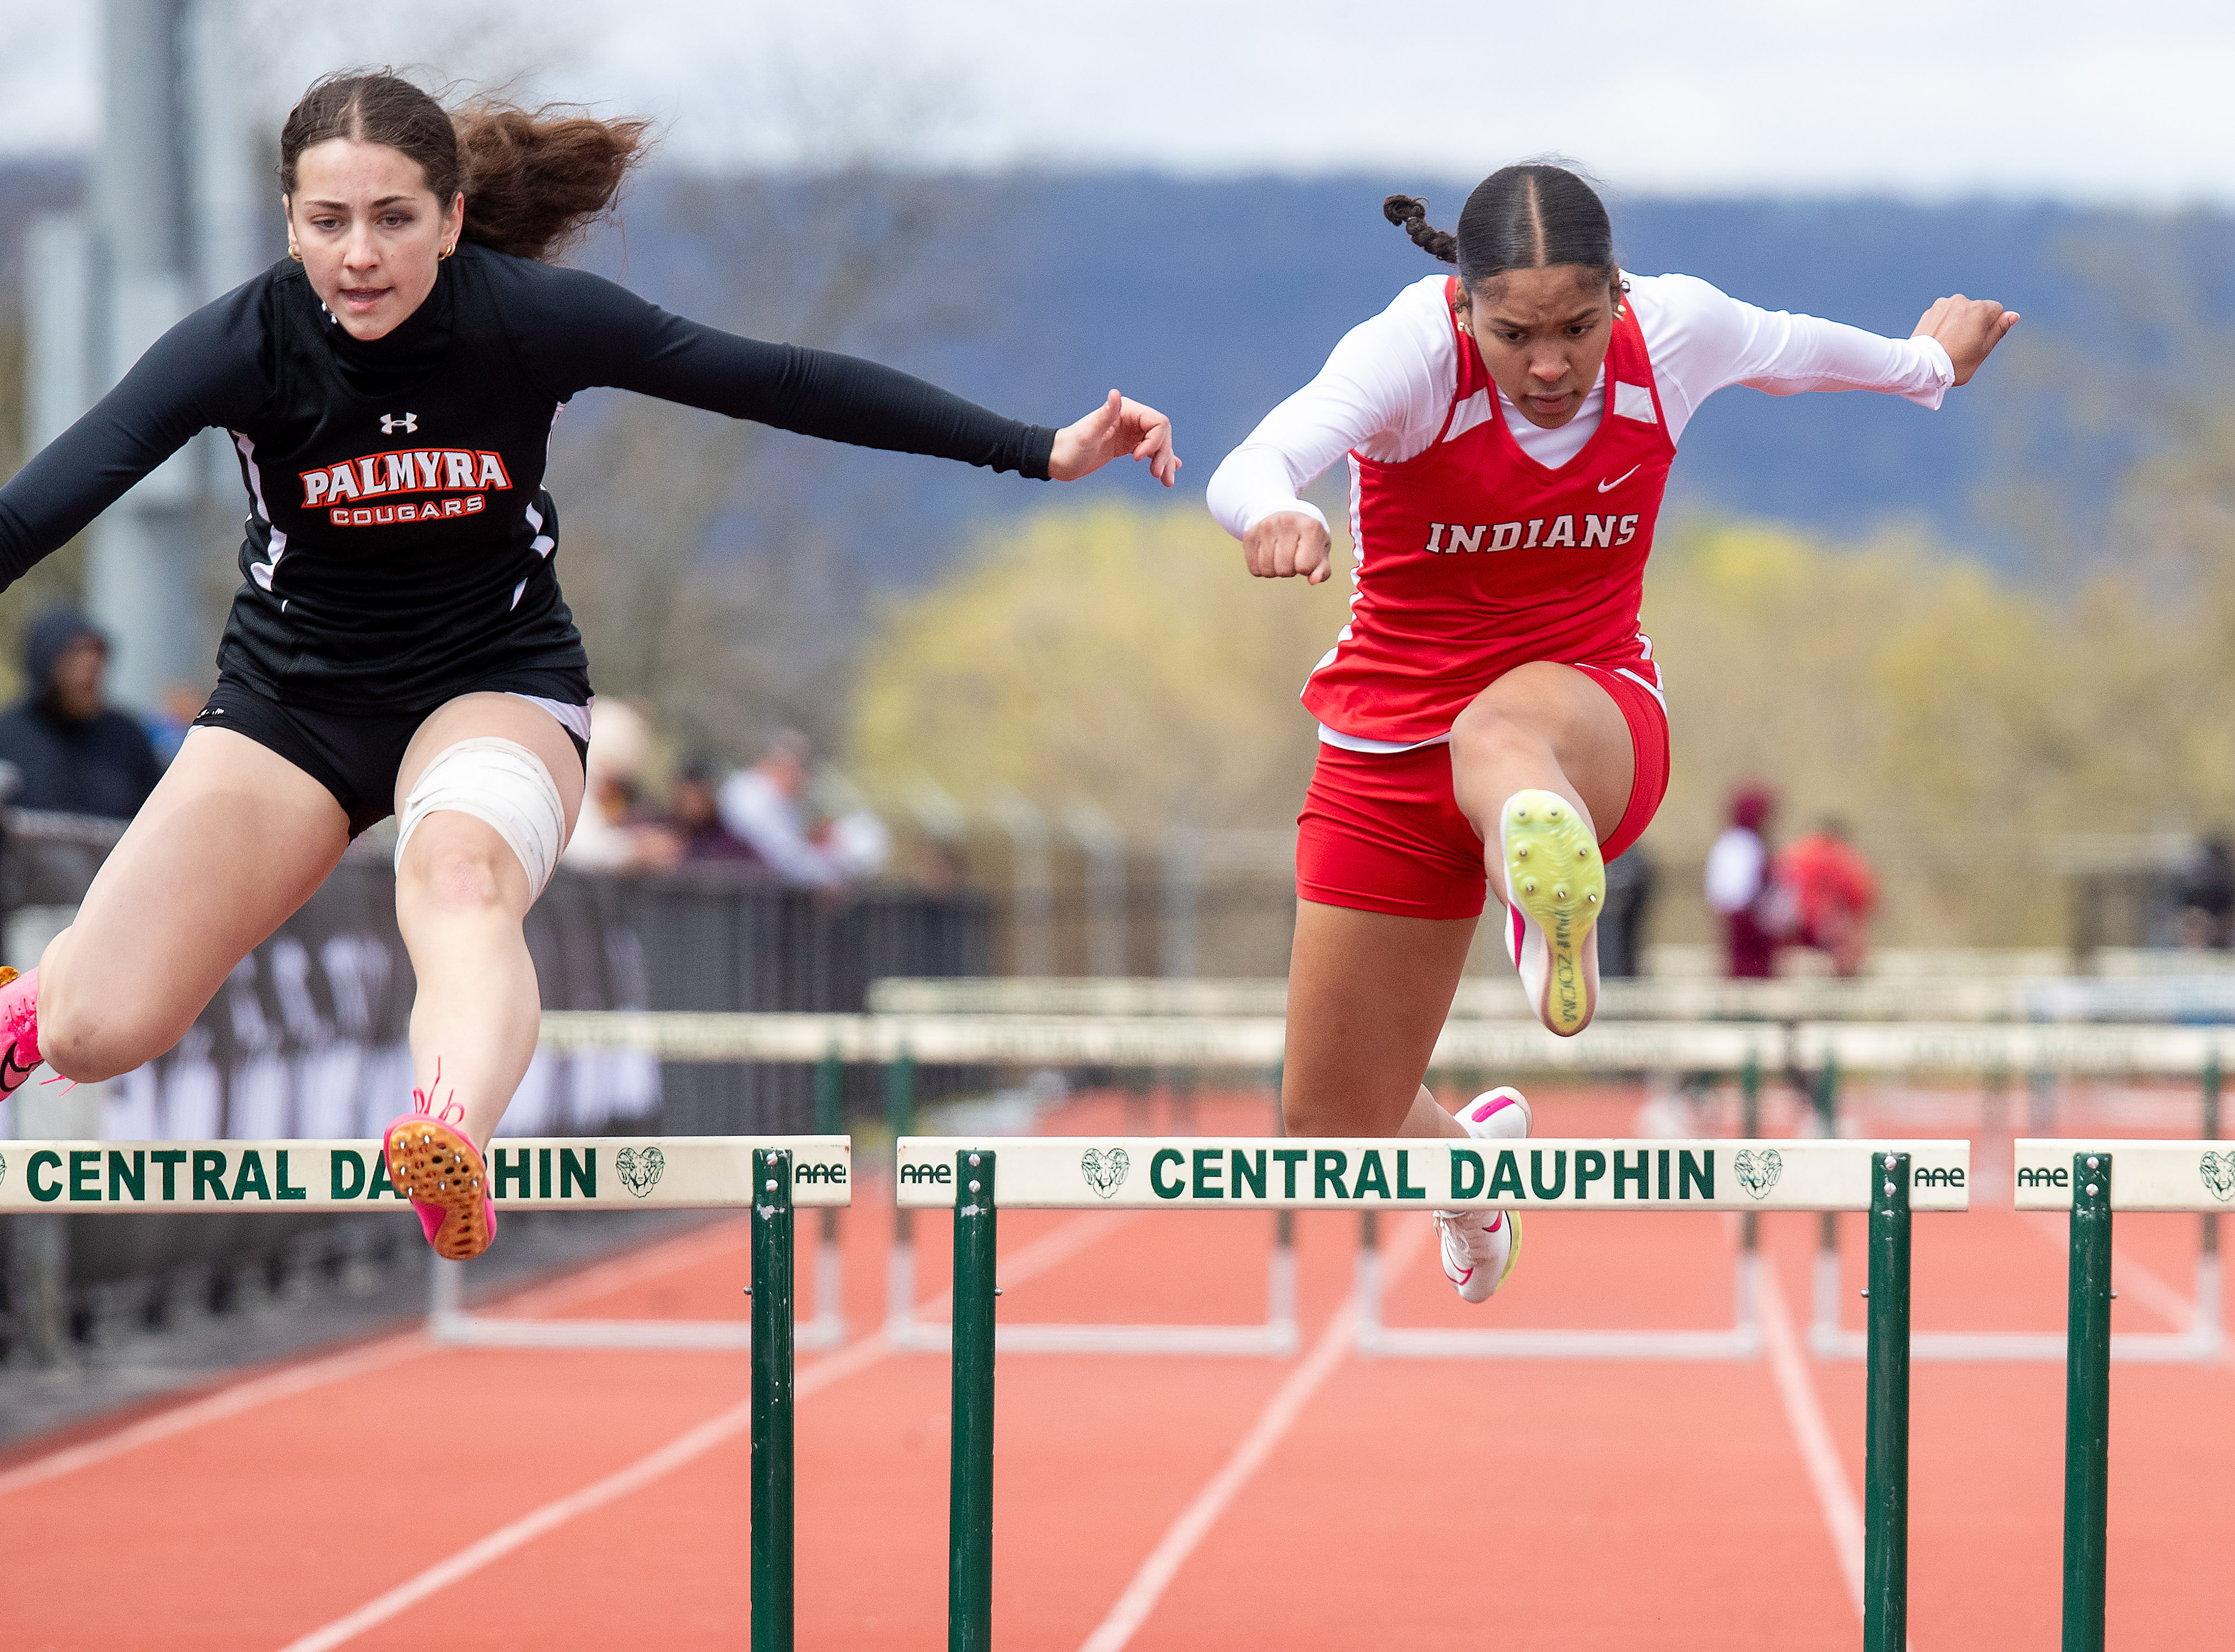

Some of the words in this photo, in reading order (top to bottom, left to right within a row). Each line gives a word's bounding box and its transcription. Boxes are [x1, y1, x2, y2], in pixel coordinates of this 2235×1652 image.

[300, 449, 512, 508] PALMYRA
[332, 496, 484, 525] COUGARS
[1425, 514, 1640, 554] INDIANS
[26, 1149, 307, 1202] CENTRAL
[330, 1148, 596, 1200] DAHIN
[1149, 1148, 1426, 1200] CENTRAL
[1450, 1149, 1715, 1200] DAUPHIN
